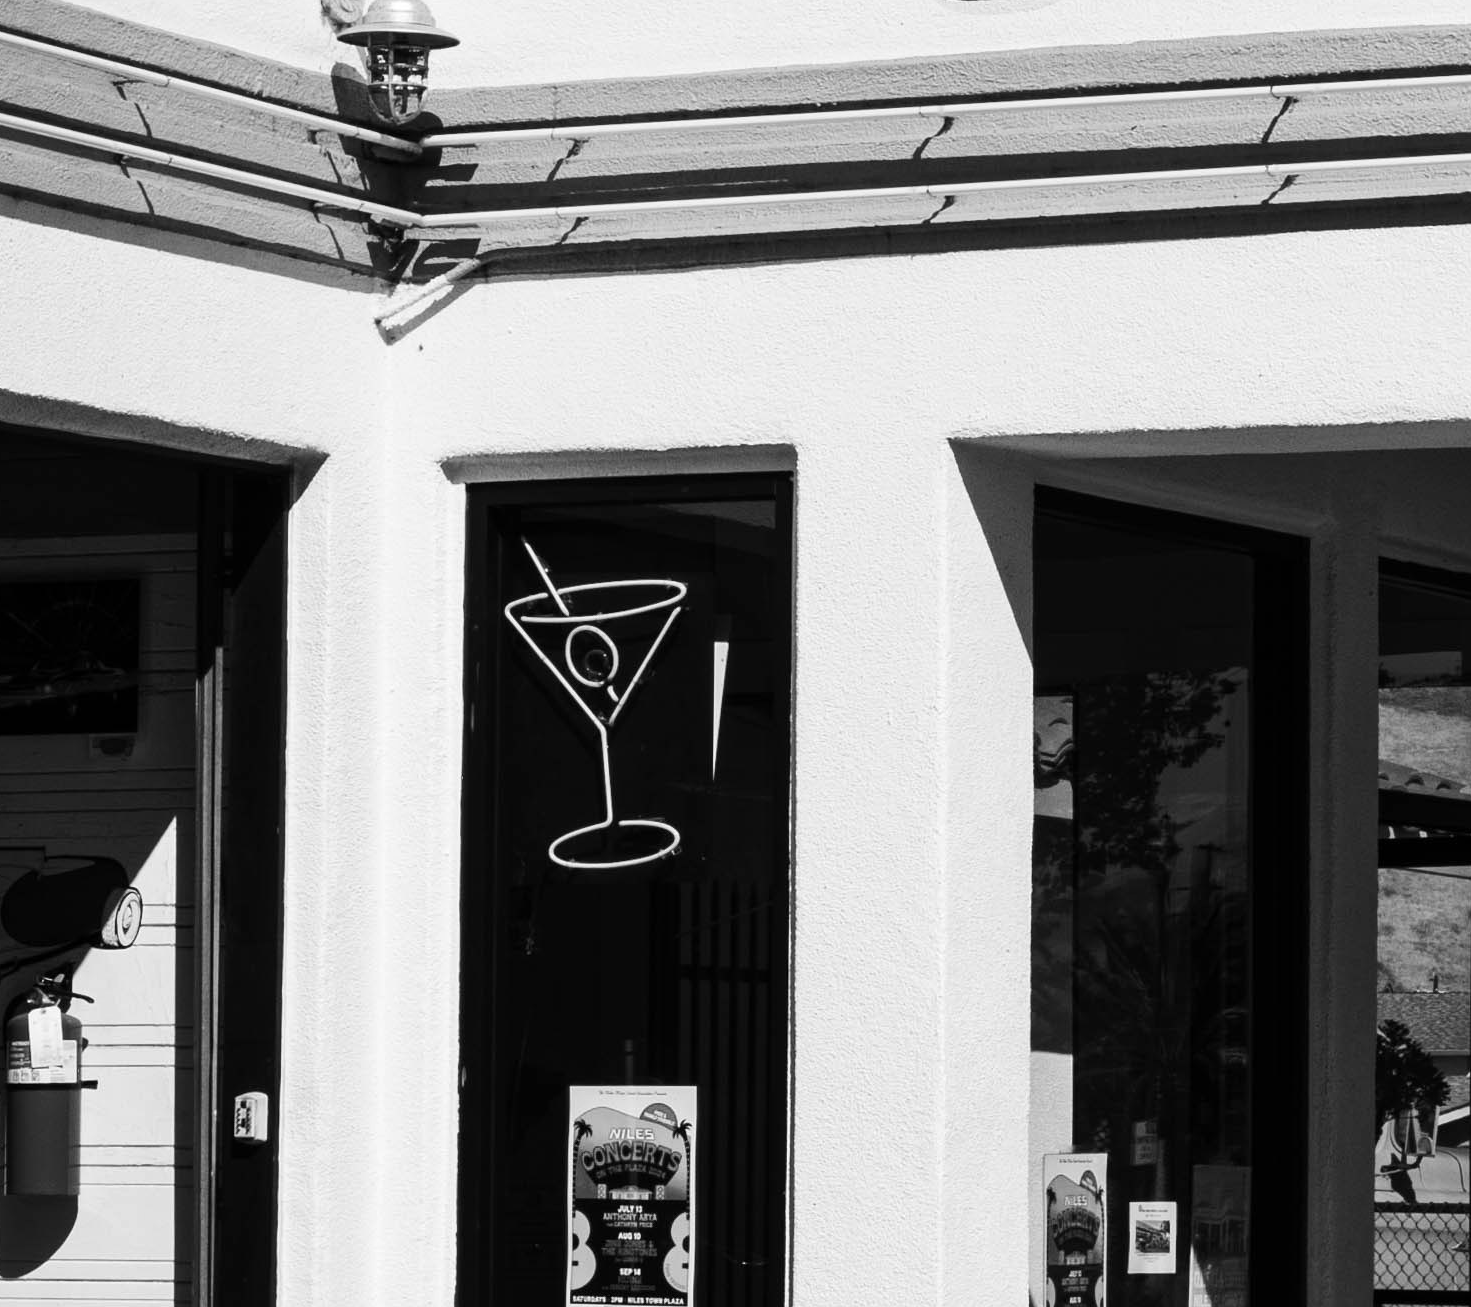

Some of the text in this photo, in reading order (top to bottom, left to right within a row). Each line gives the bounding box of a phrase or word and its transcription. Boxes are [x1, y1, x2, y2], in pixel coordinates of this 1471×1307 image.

[609, 1128, 655, 1140] NILES
[581, 1140, 682, 1172] CONCERTS
[617, 1205, 634, 1213] JULY
[618, 1232, 632, 1240] AUG
[572, 1295, 606, 1303] SATURDAYS
[627, 1296, 644, 1304] NILES
[664, 1297, 684, 1305] PLAZA
